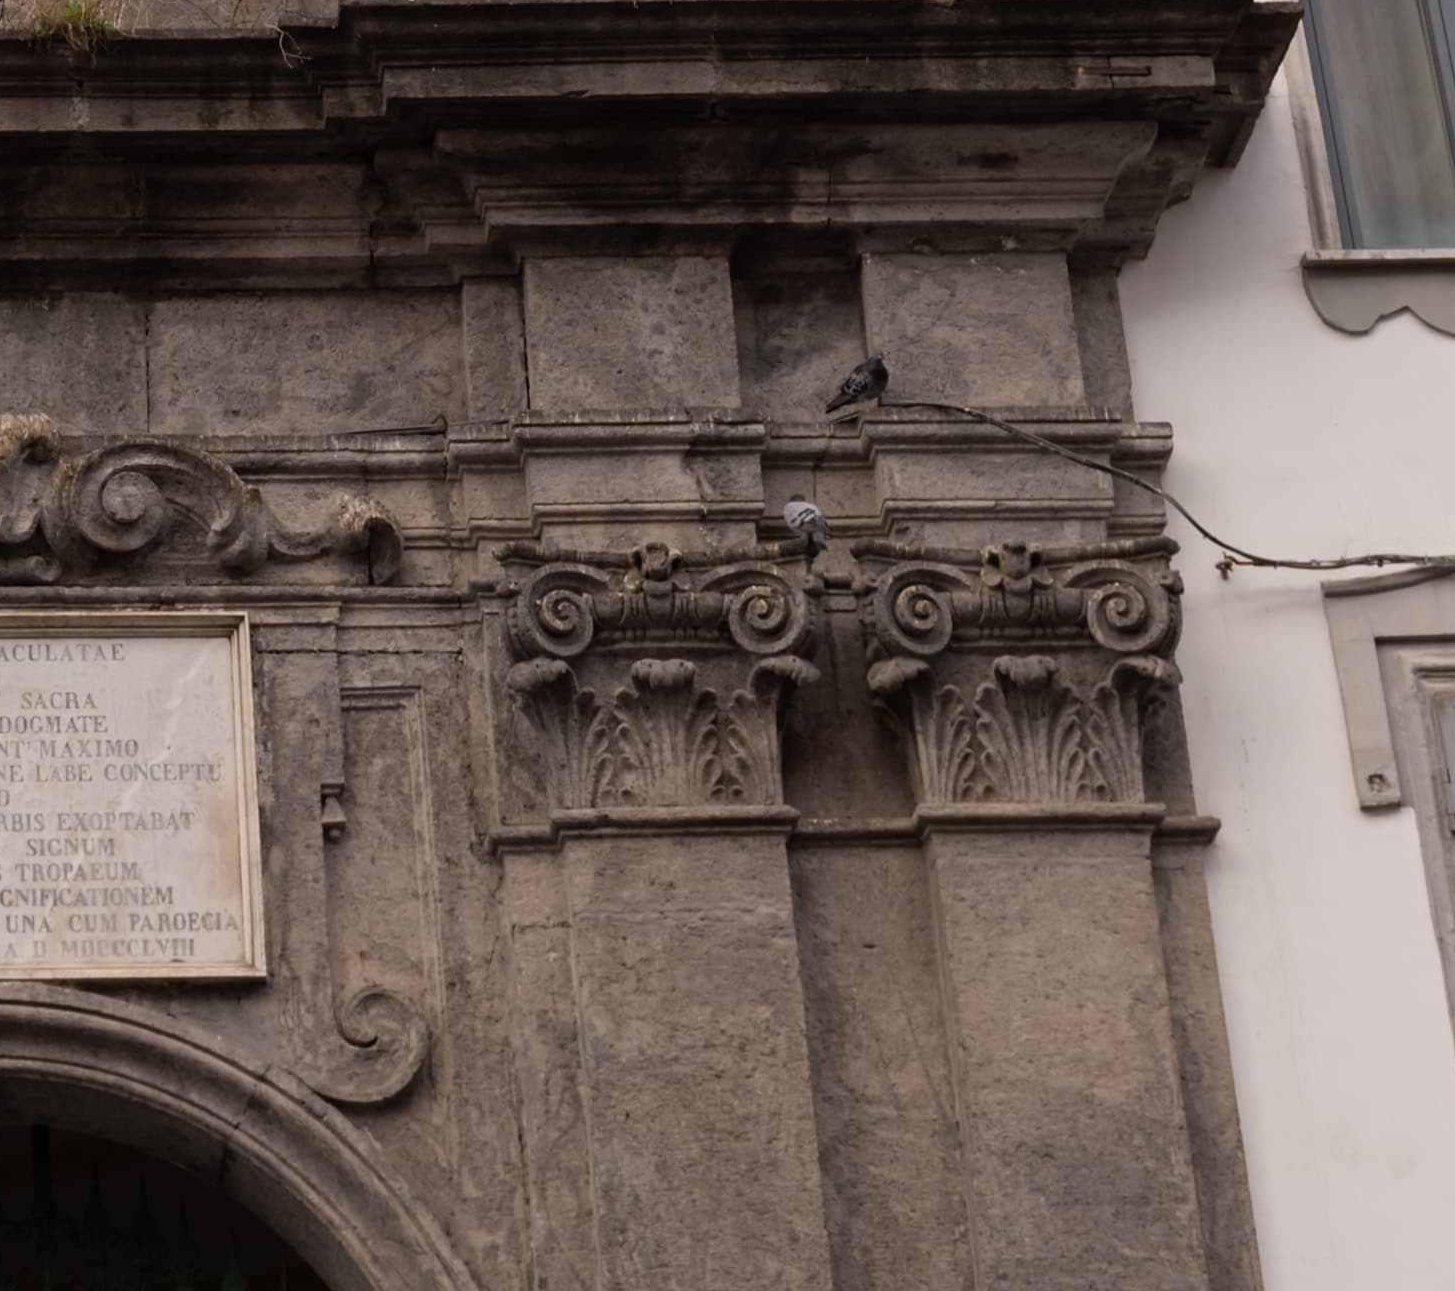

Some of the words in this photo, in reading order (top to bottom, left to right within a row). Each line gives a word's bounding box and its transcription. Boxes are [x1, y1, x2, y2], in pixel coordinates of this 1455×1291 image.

[21, 692, 97, 710] SACRA
[40, 739, 139, 758] MAXIMO
[35, 764, 93, 782] LABE
[104, 763, 222, 781] CONCEPTU
[57, 811, 195, 832] EXOPTABAT
[26, 837, 115, 857] SIGNUM
[15, 862, 139, 882] TROPAEUM
[5, 915, 52, 933] UNA
[68, 914, 117, 933] CUM
[129, 912, 238, 932] PAROECIA
[4, 943, 18, 959] A
[33, 940, 47, 958] D
[61, 938, 195, 958] MDCCCLVIII
